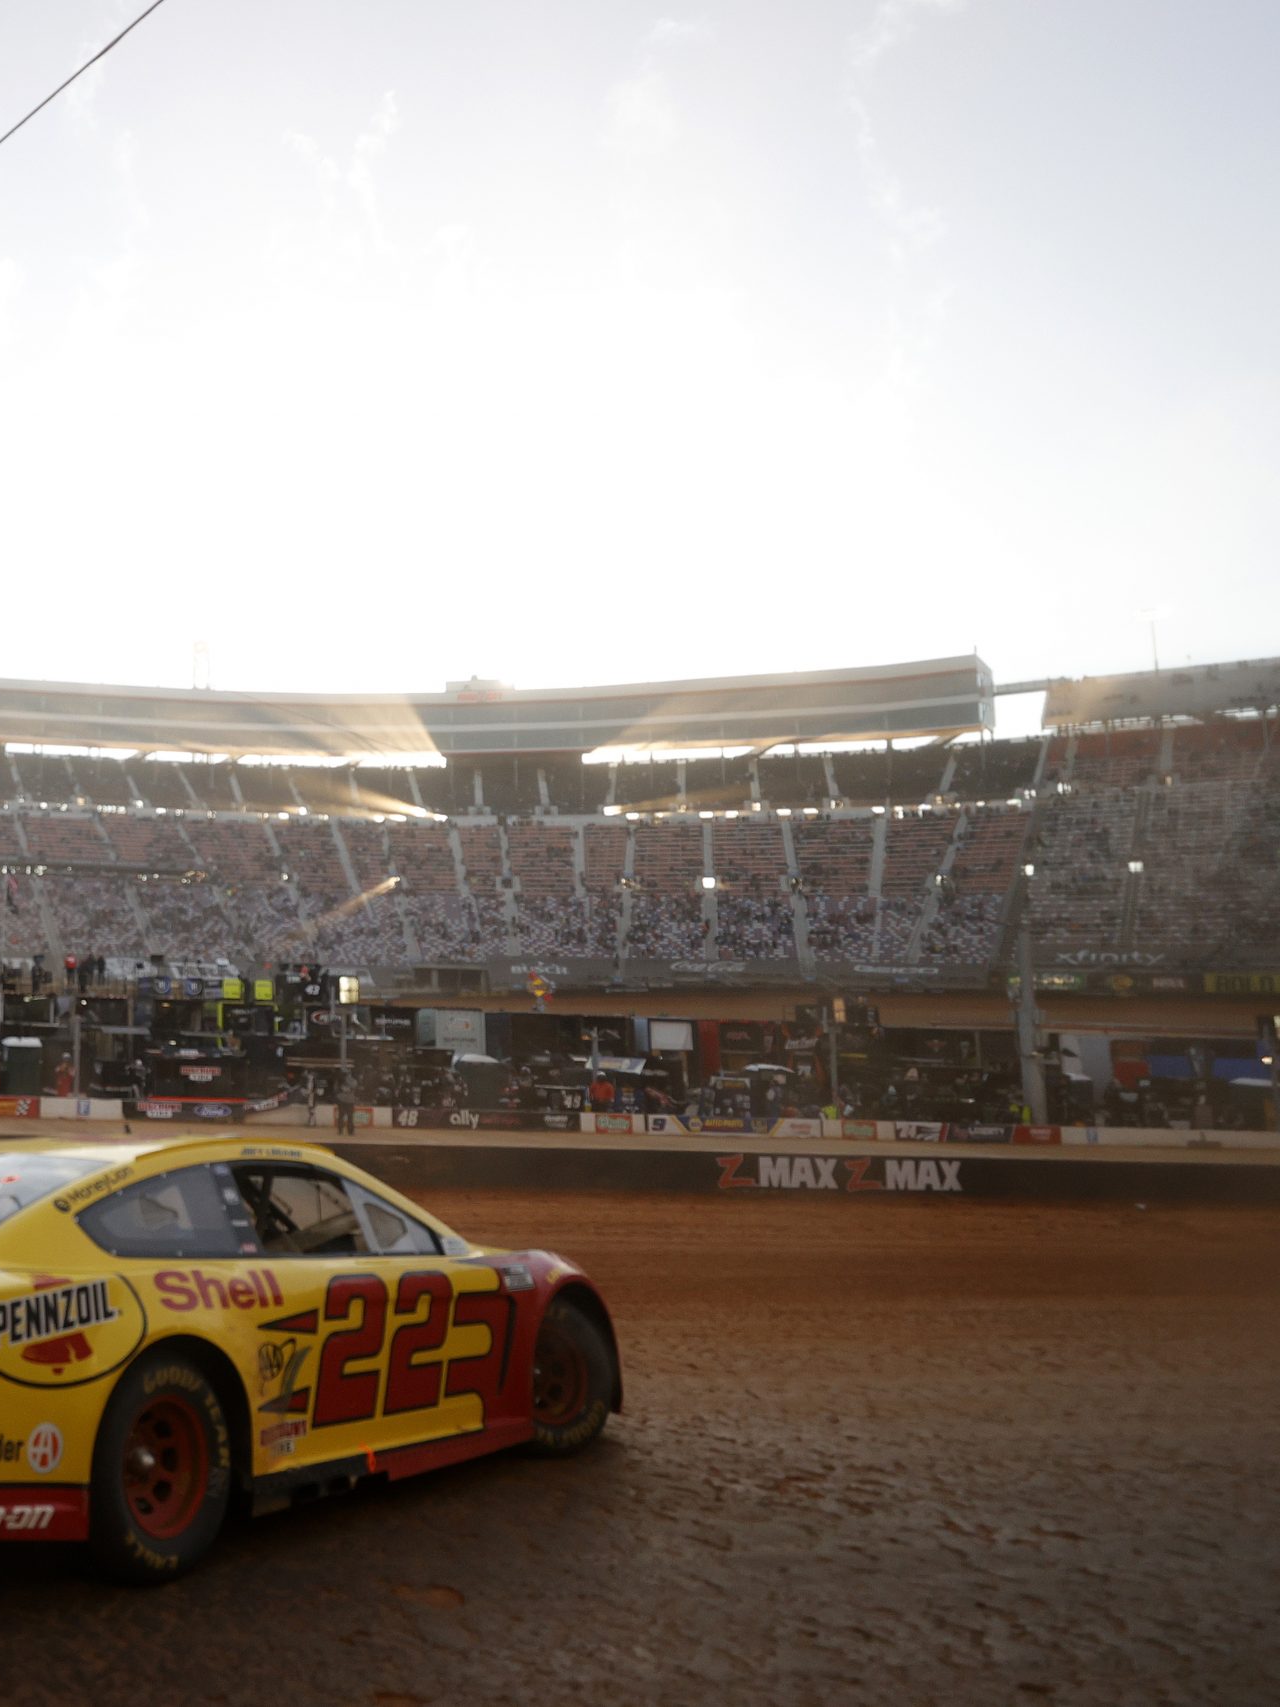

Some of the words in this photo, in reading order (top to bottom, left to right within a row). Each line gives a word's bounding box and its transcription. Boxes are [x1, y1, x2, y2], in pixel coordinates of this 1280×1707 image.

[1055, 950, 1165, 966] xfinity
[853, 964, 939, 975] GEICO
[397, 1110, 419, 1127] 48
[449, 1109, 480, 1130] ally
[651, 1118, 667, 1132] 9
[153, 1269, 286, 1312] Shell
[311, 1270, 455, 1429] 22
